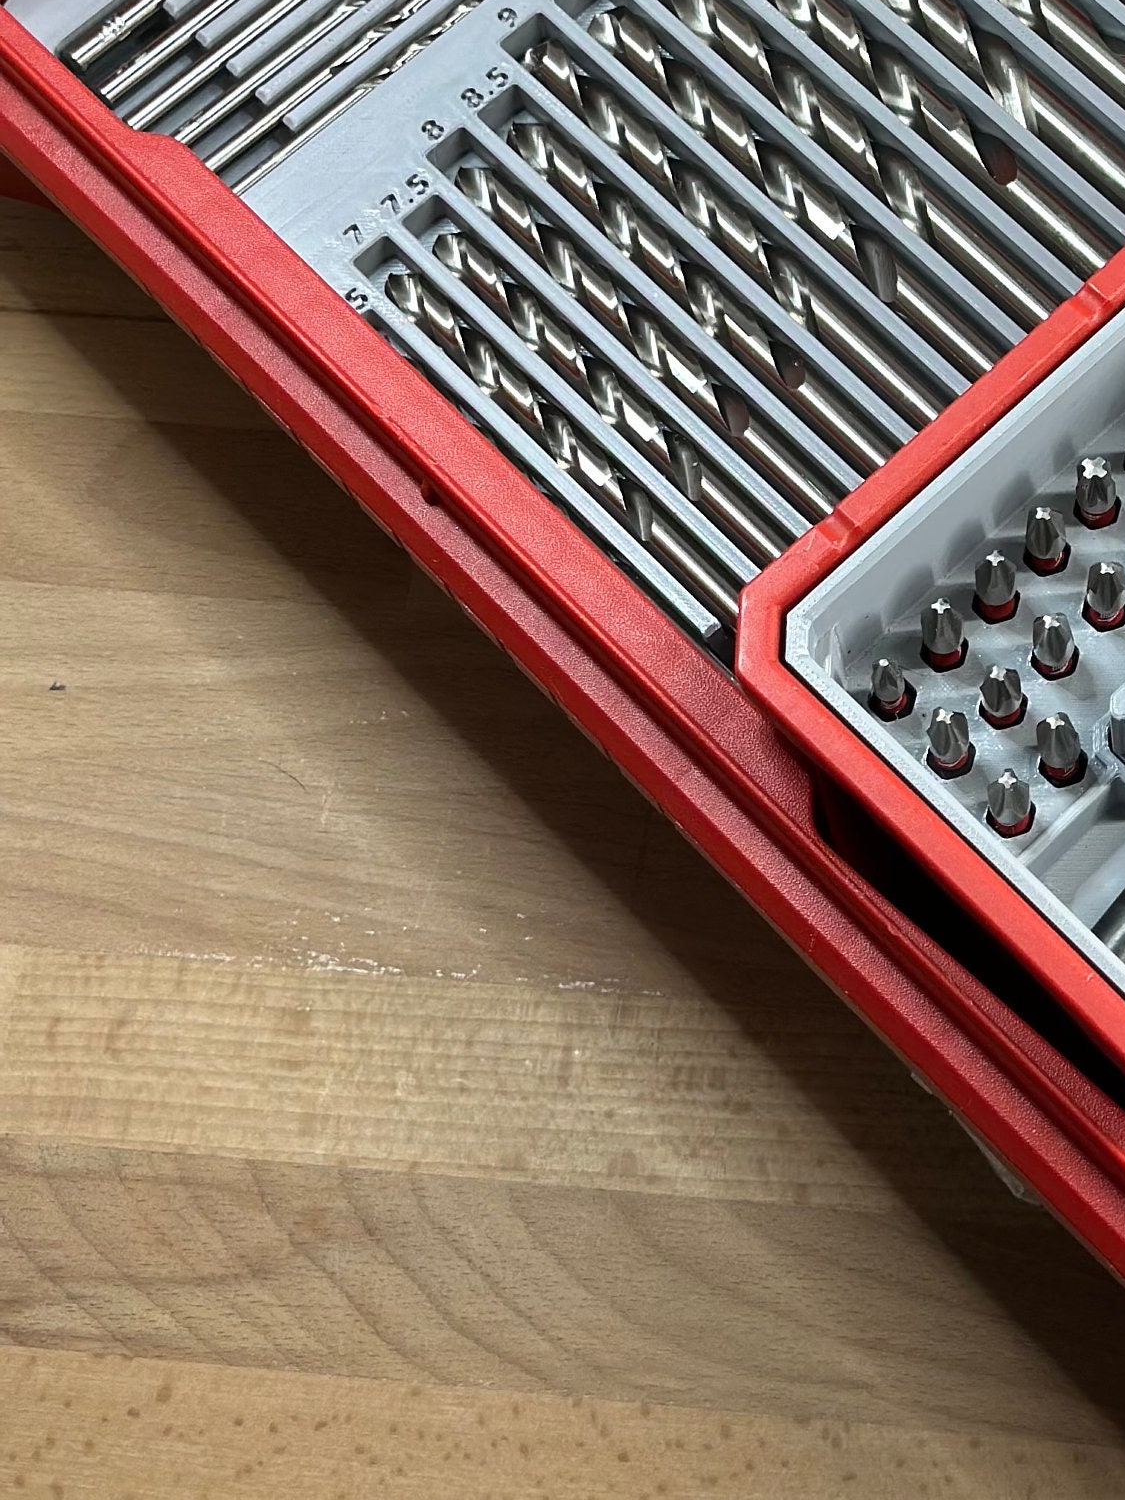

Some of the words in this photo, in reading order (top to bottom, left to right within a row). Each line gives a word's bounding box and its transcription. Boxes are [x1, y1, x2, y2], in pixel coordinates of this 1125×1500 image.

[497, 7, 518, 27] 9
[461, 67, 509, 108] 8.5
[421, 120, 444, 140] 8
[380, 173, 430, 214] 7.5
[343, 224, 362, 244] 7
